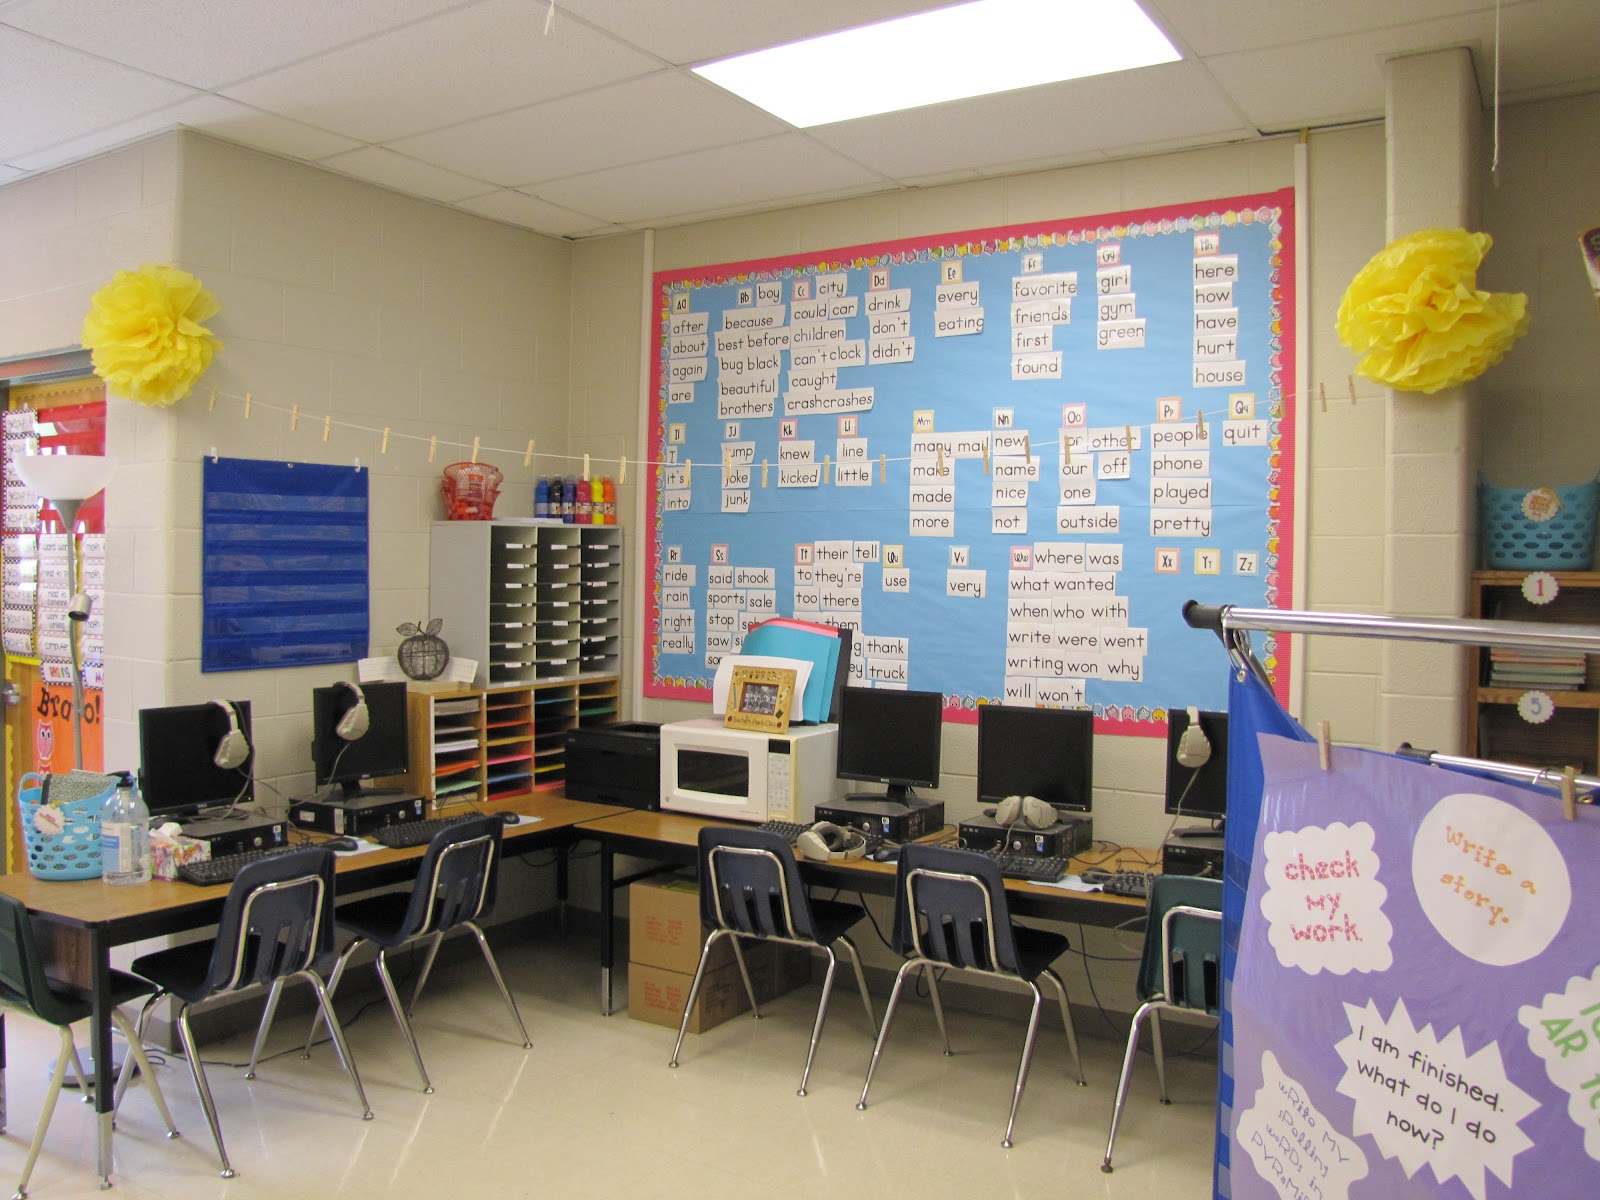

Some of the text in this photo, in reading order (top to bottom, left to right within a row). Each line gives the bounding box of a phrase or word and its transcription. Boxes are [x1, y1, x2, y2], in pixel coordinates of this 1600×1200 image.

[1102, 250, 1115, 263] Gg
[948, 268, 956, 279] Ee
[1196, 264, 1234, 279] here
[875, 276, 884, 286] Dd
[1014, 281, 1077, 296] favorite
[1101, 276, 1127, 293] girl
[759, 286, 779, 302] boy
[820, 282, 843, 297] city
[1196, 289, 1229, 302] how
[869, 297, 900, 311] drink
[938, 291, 977, 305] every
[794, 304, 854, 319] could car
[1015, 306, 1067, 323] friends
[1101, 304, 1132, 321] gym
[673, 320, 703, 334] after
[726, 317, 773, 329] because
[873, 317, 907, 334] don't
[938, 316, 984, 333] eating
[1197, 314, 1236, 329] have
[794, 326, 844, 342] children
[1016, 333, 1048, 347] first
[1099, 328, 1144, 342] green
[673, 341, 705, 353] about
[718, 333, 789, 351] best before
[1197, 340, 1234, 354] hurt
[795, 345, 860, 365] can't clock
[873, 342, 912, 358] didn't
[721, 355, 778, 374] bug black
[1016, 358, 1057, 373] found
[673, 367, 702, 380] again
[792, 372, 836, 390] caught
[1196, 368, 1242, 382] house
[721, 379, 774, 395] beautiful
[672, 393, 691, 401] are
[721, 400, 772, 415] brothers
[1164, 405, 1173, 417] Pp
[998, 415, 1009, 425] Nn
[1068, 411, 1081, 423] Oo
[784, 425, 792, 435] Kk
[1153, 426, 1208, 446] people
[1225, 425, 1260, 445] quit
[914, 438, 989, 457] many mail
[995, 436, 1024, 448] new
[1092, 434, 1137, 449] other
[780, 447, 810, 459] knew
[843, 445, 863, 457] line
[913, 462, 949, 477] make
[996, 466, 1035, 475] name
[1063, 466, 1087, 475] our
[1103, 458, 1127, 473] off
[1154, 455, 1202, 476] phone
[668, 471, 684, 484] it's
[781, 469, 817, 483] kicked
[838, 468, 868, 481] little
[726, 492, 748, 508] junk
[913, 488, 951, 502] made
[997, 488, 1025, 498] nice
[1064, 489, 1090, 498] one
[1154, 483, 1208, 504] played
[668, 498, 688, 508] into
[913, 519, 949, 527] more
[996, 516, 1019, 528] not
[1061, 513, 1117, 528] outside
[1154, 517, 1209, 537] pretty
[817, 546, 848, 559] their
[856, 545, 876, 558] tell
[954, 552, 964, 562] Vv
[1035, 549, 1119, 564] where was
[1163, 555, 1172, 567] Xx
[1240, 558, 1252, 571] Zz
[666, 568, 687, 581] ride
[709, 570, 768, 584] said shook
[798, 568, 861, 587] to they're
[886, 578, 906, 586] use
[950, 583, 980, 598] very
[1011, 576, 1114, 590] what wanted
[1537, 585, 1543, 596] 1
[667, 592, 688, 601] rain
[708, 593, 772, 607] sports sale
[796, 593, 859, 606] too there
[1011, 603, 1126, 618] when who with
[665, 614, 692, 632] right
[710, 614, 734, 629] stop
[663, 636, 693, 654] really
[708, 638, 729, 646] saw
[867, 639, 903, 653] thank
[1009, 631, 1144, 647] write were went
[870, 665, 904, 679] truck
[1008, 656, 1139, 680] writing won why
[1007, 683, 1082, 701] will won't
[37, 688, 99, 724] Brao!
[1531, 698, 1541, 715] 5
[1285, 850, 1359, 881] check
[1521, 880, 1535, 894] a
[1440, 873, 1509, 926] story.
[1291, 914, 1362, 941] work.
[1541, 1019, 1588, 1058] AR
[1360, 1025, 1503, 1112] I am finished.
[1416, 1094, 1442, 1114] do
[1451, 1108, 1455, 1124] I
[1466, 1122, 1496, 1142] do
[1387, 1111, 1444, 1149] now?
